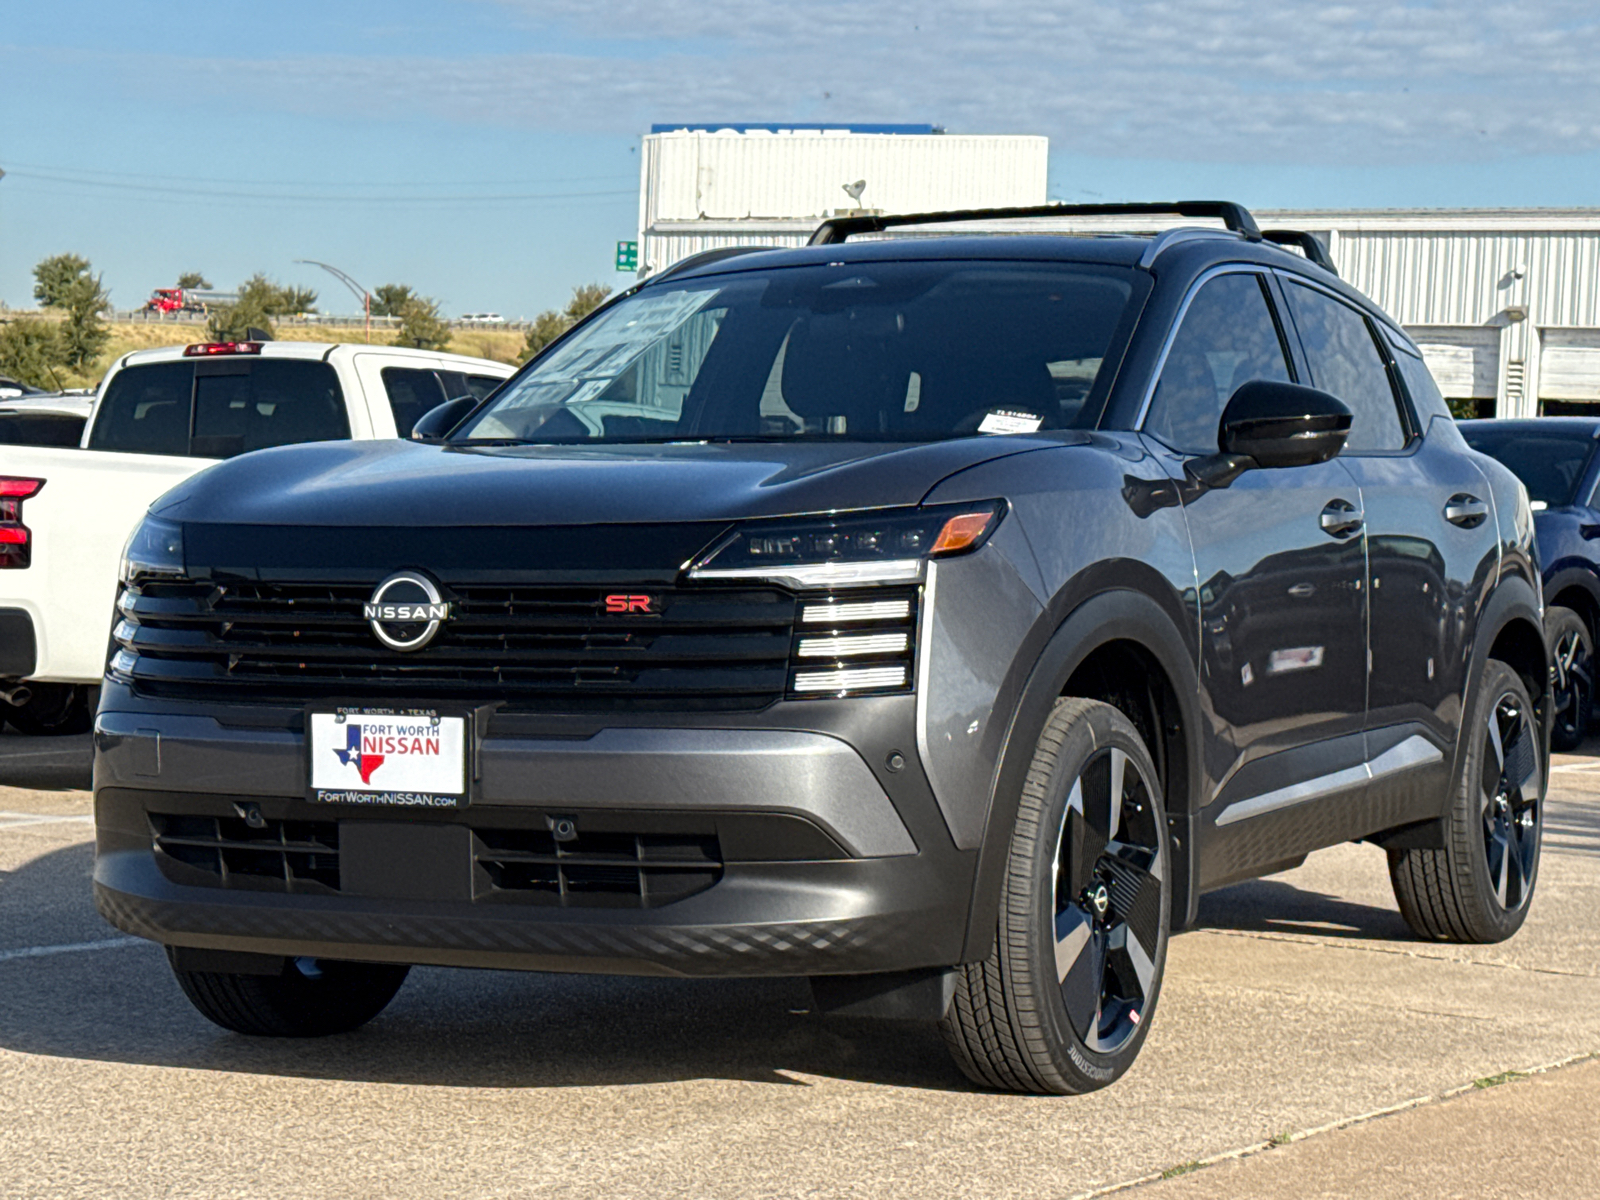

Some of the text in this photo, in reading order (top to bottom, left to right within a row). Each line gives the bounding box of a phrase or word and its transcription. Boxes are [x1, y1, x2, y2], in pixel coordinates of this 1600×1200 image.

[605, 594, 650, 612] SR
[364, 605, 445, 619] NISSAN
[363, 707, 395, 715] WORTH
[407, 708, 437, 717] TEXAS
[363, 724, 440, 737] FORT WORTH
[363, 736, 440, 755] NISSAN
